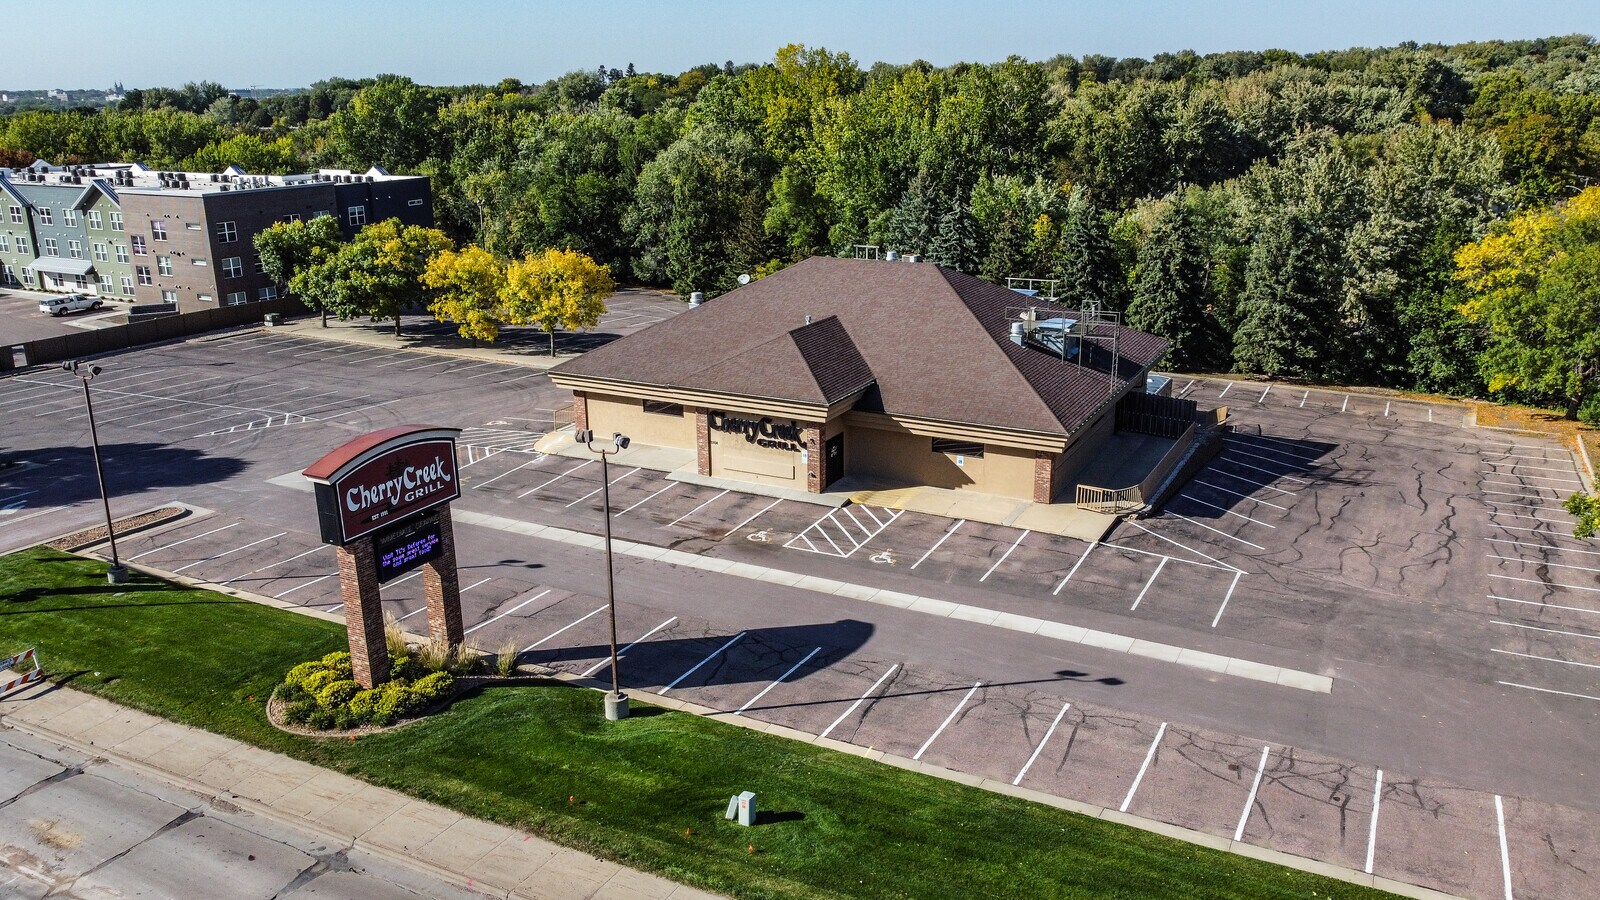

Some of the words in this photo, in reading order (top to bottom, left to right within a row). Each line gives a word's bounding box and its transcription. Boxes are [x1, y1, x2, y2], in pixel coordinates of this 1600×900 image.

[757, 438, 801, 452] GRILL
[404, 481, 444, 502] GRILL
[392, 553, 405, 562] same
[406, 546, 420, 556] great
[421, 538, 439, 549] service
[392, 559, 403, 568] and
[403, 552, 417, 563] great
